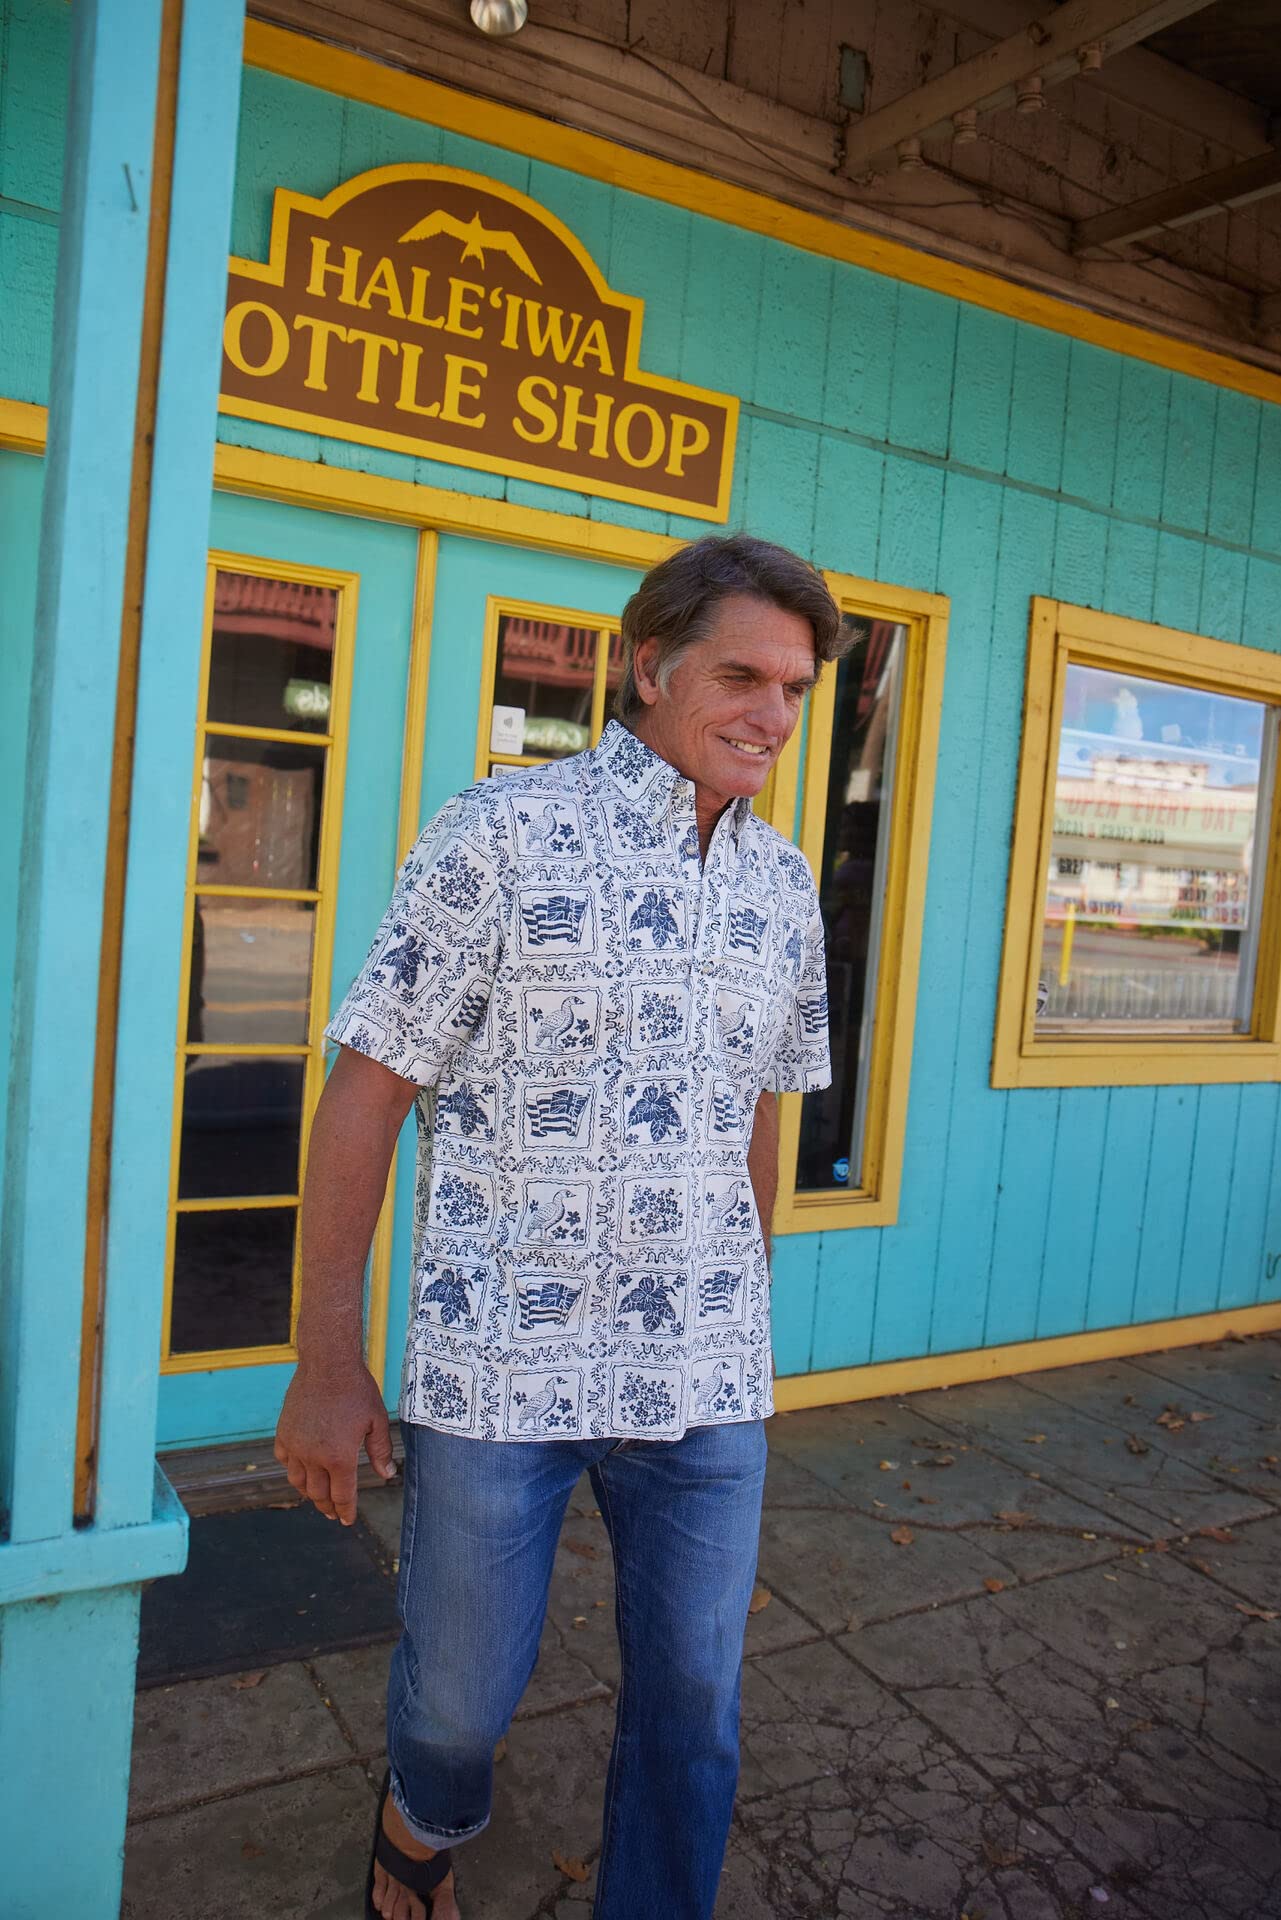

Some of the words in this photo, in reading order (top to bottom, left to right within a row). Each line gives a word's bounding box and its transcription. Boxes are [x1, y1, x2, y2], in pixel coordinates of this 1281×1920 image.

[306, 236, 615, 376] HALE‘IWA
[223, 301, 488, 429] OTTLE
[512, 375, 711, 477] SHOP
[1066, 787, 1121, 819] OPEN
[1132, 791, 1191, 829] EVERY
[1201, 799, 1238, 833] DAY
